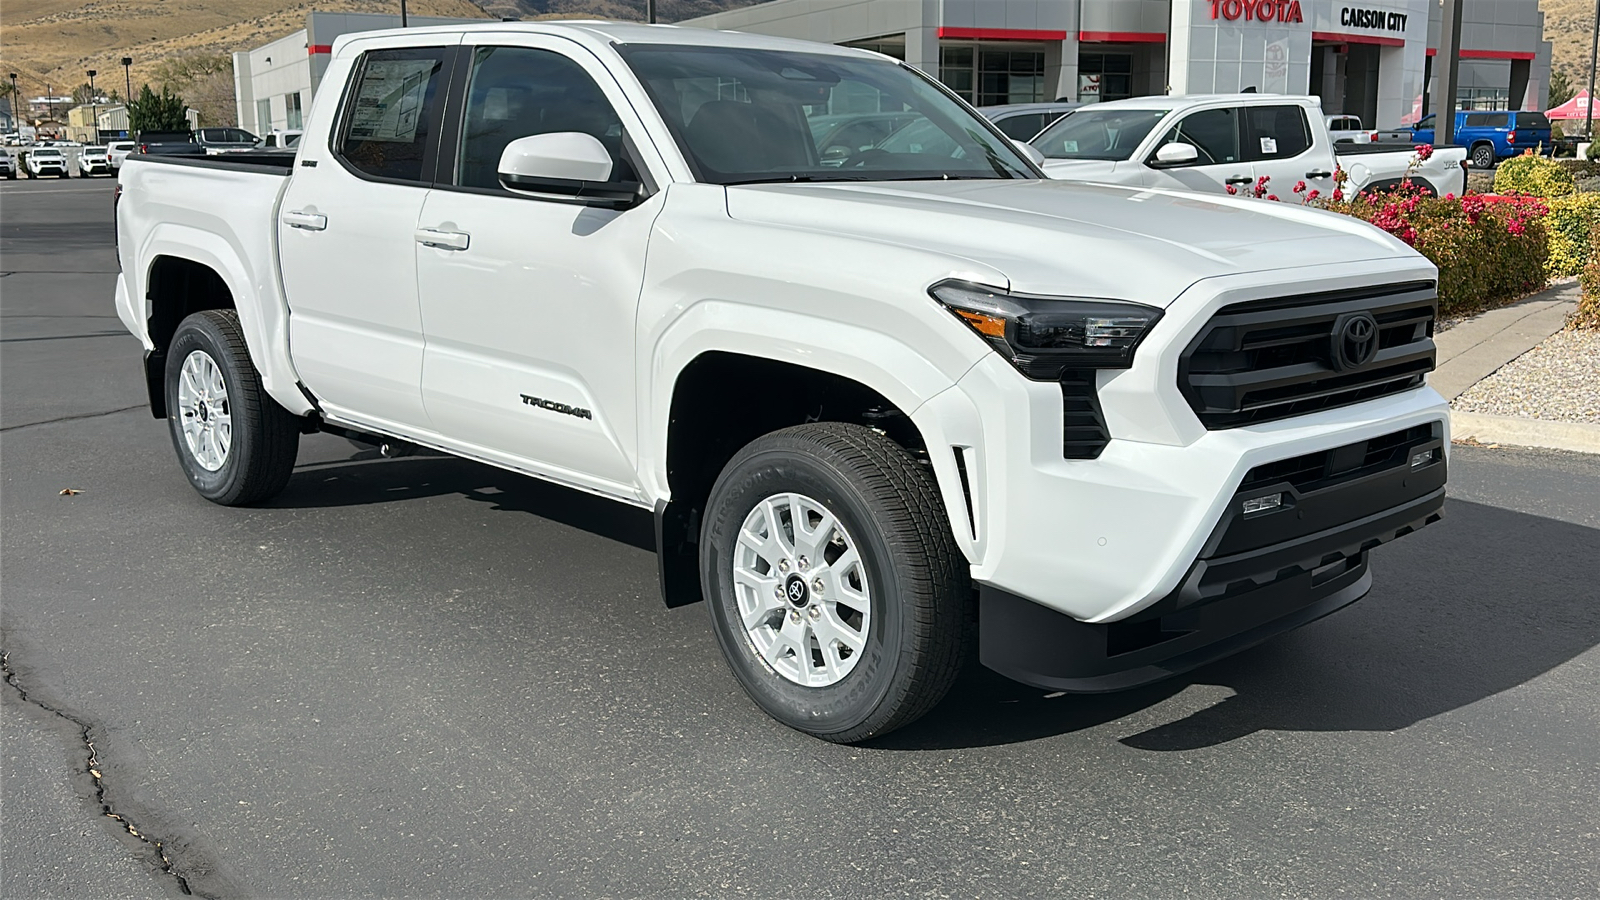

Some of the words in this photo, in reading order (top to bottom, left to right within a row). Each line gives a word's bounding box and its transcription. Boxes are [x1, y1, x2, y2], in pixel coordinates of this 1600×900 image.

[1207, 0, 1304, 23] TOYOTA
[1340, 7, 1386, 30] CARSON
[1387, 12, 1408, 32] CITY
[520, 393, 592, 420] TACOMA
